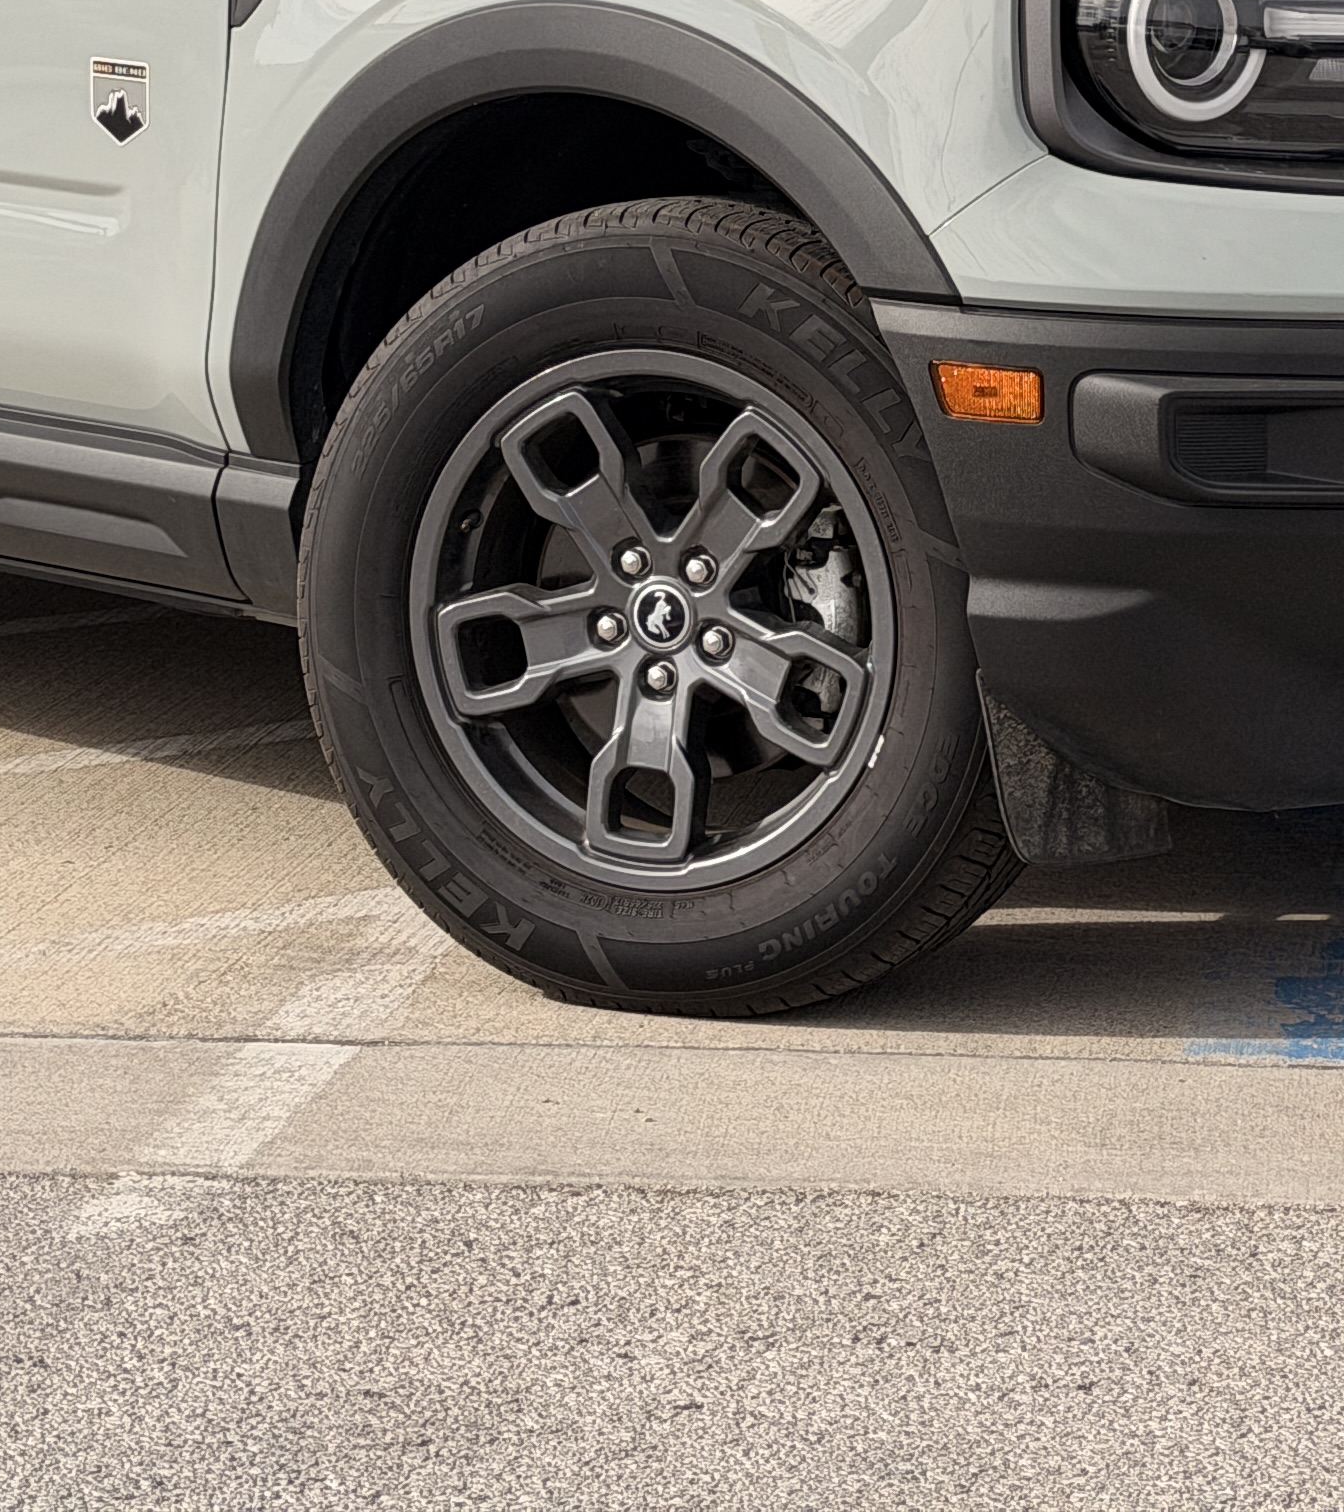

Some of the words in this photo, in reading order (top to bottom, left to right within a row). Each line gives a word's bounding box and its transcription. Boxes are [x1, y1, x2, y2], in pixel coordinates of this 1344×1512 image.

[351, 303, 485, 481] 225/65R17
[737, 282, 934, 464] KELLY
[906, 735, 960, 837] EDGE
[356, 767, 536, 952] KELLY
[758, 852, 899, 962] TOURING
[705, 959, 755, 980] PLUS
